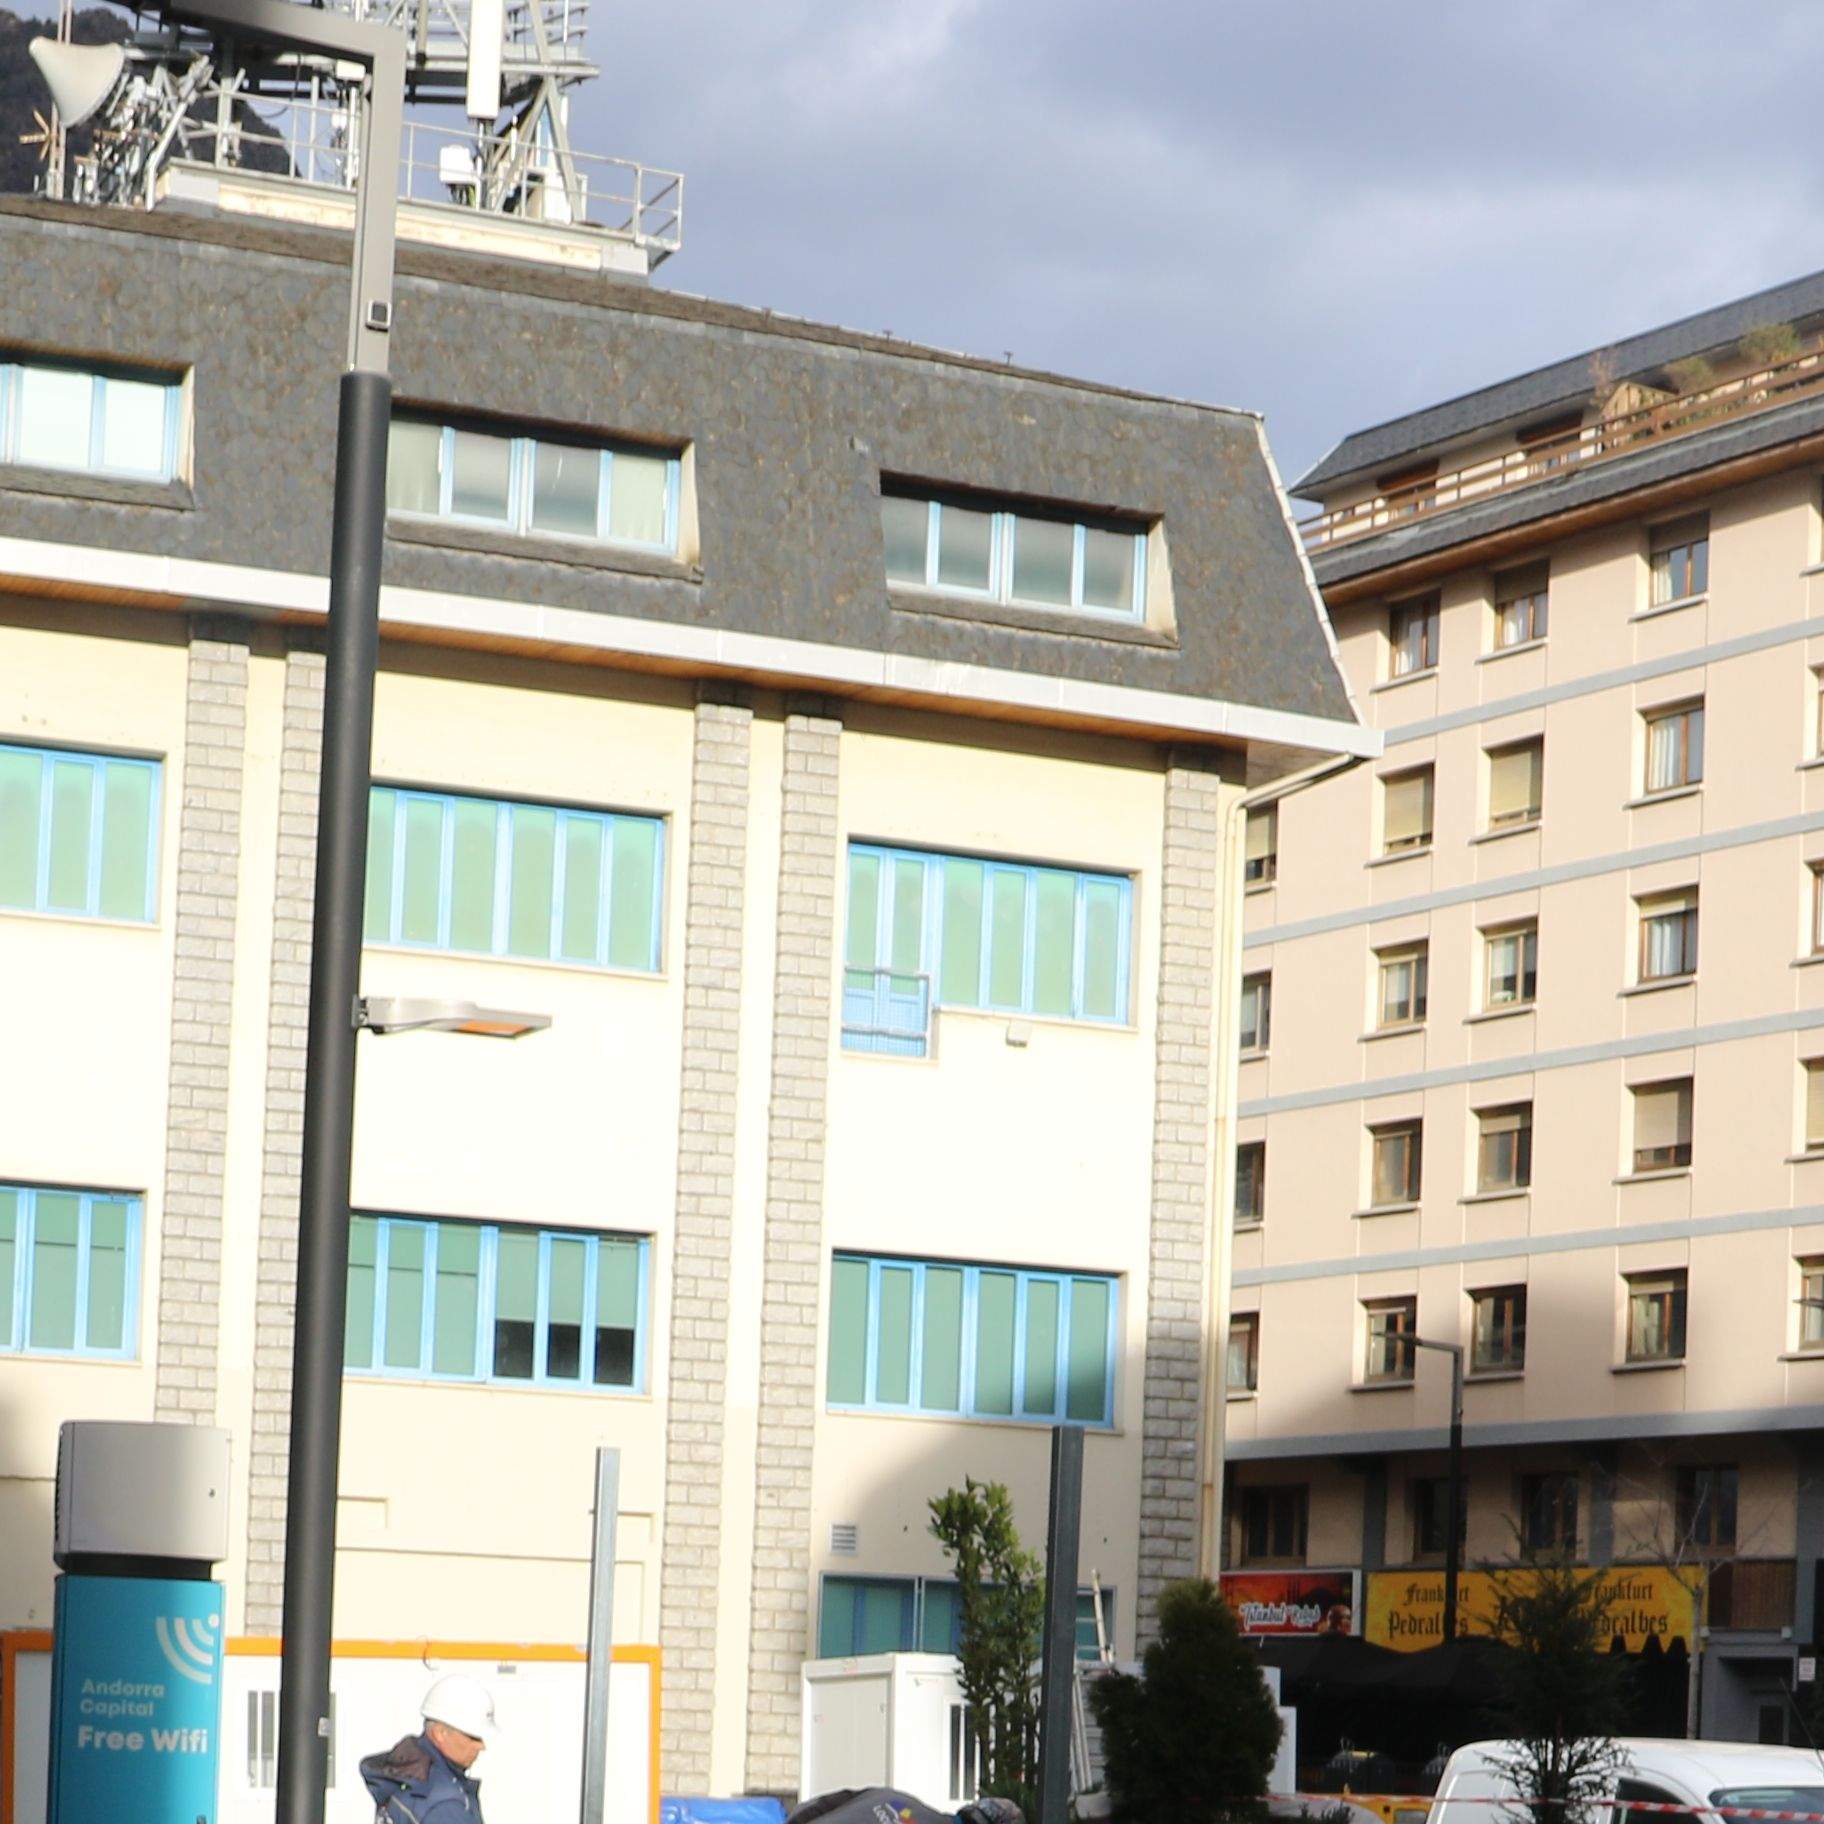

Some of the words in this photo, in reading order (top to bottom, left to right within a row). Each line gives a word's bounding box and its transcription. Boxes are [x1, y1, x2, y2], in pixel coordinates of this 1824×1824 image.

[1402, 1582, 1470, 1607] Frankrt
[1387, 1609, 1469, 1642] Pedrals
[80, 1679, 166, 1698] Andorra
[79, 1698, 155, 1719] Capital
[77, 1725, 145, 1751] Free
[150, 1727, 209, 1755] Wifi
